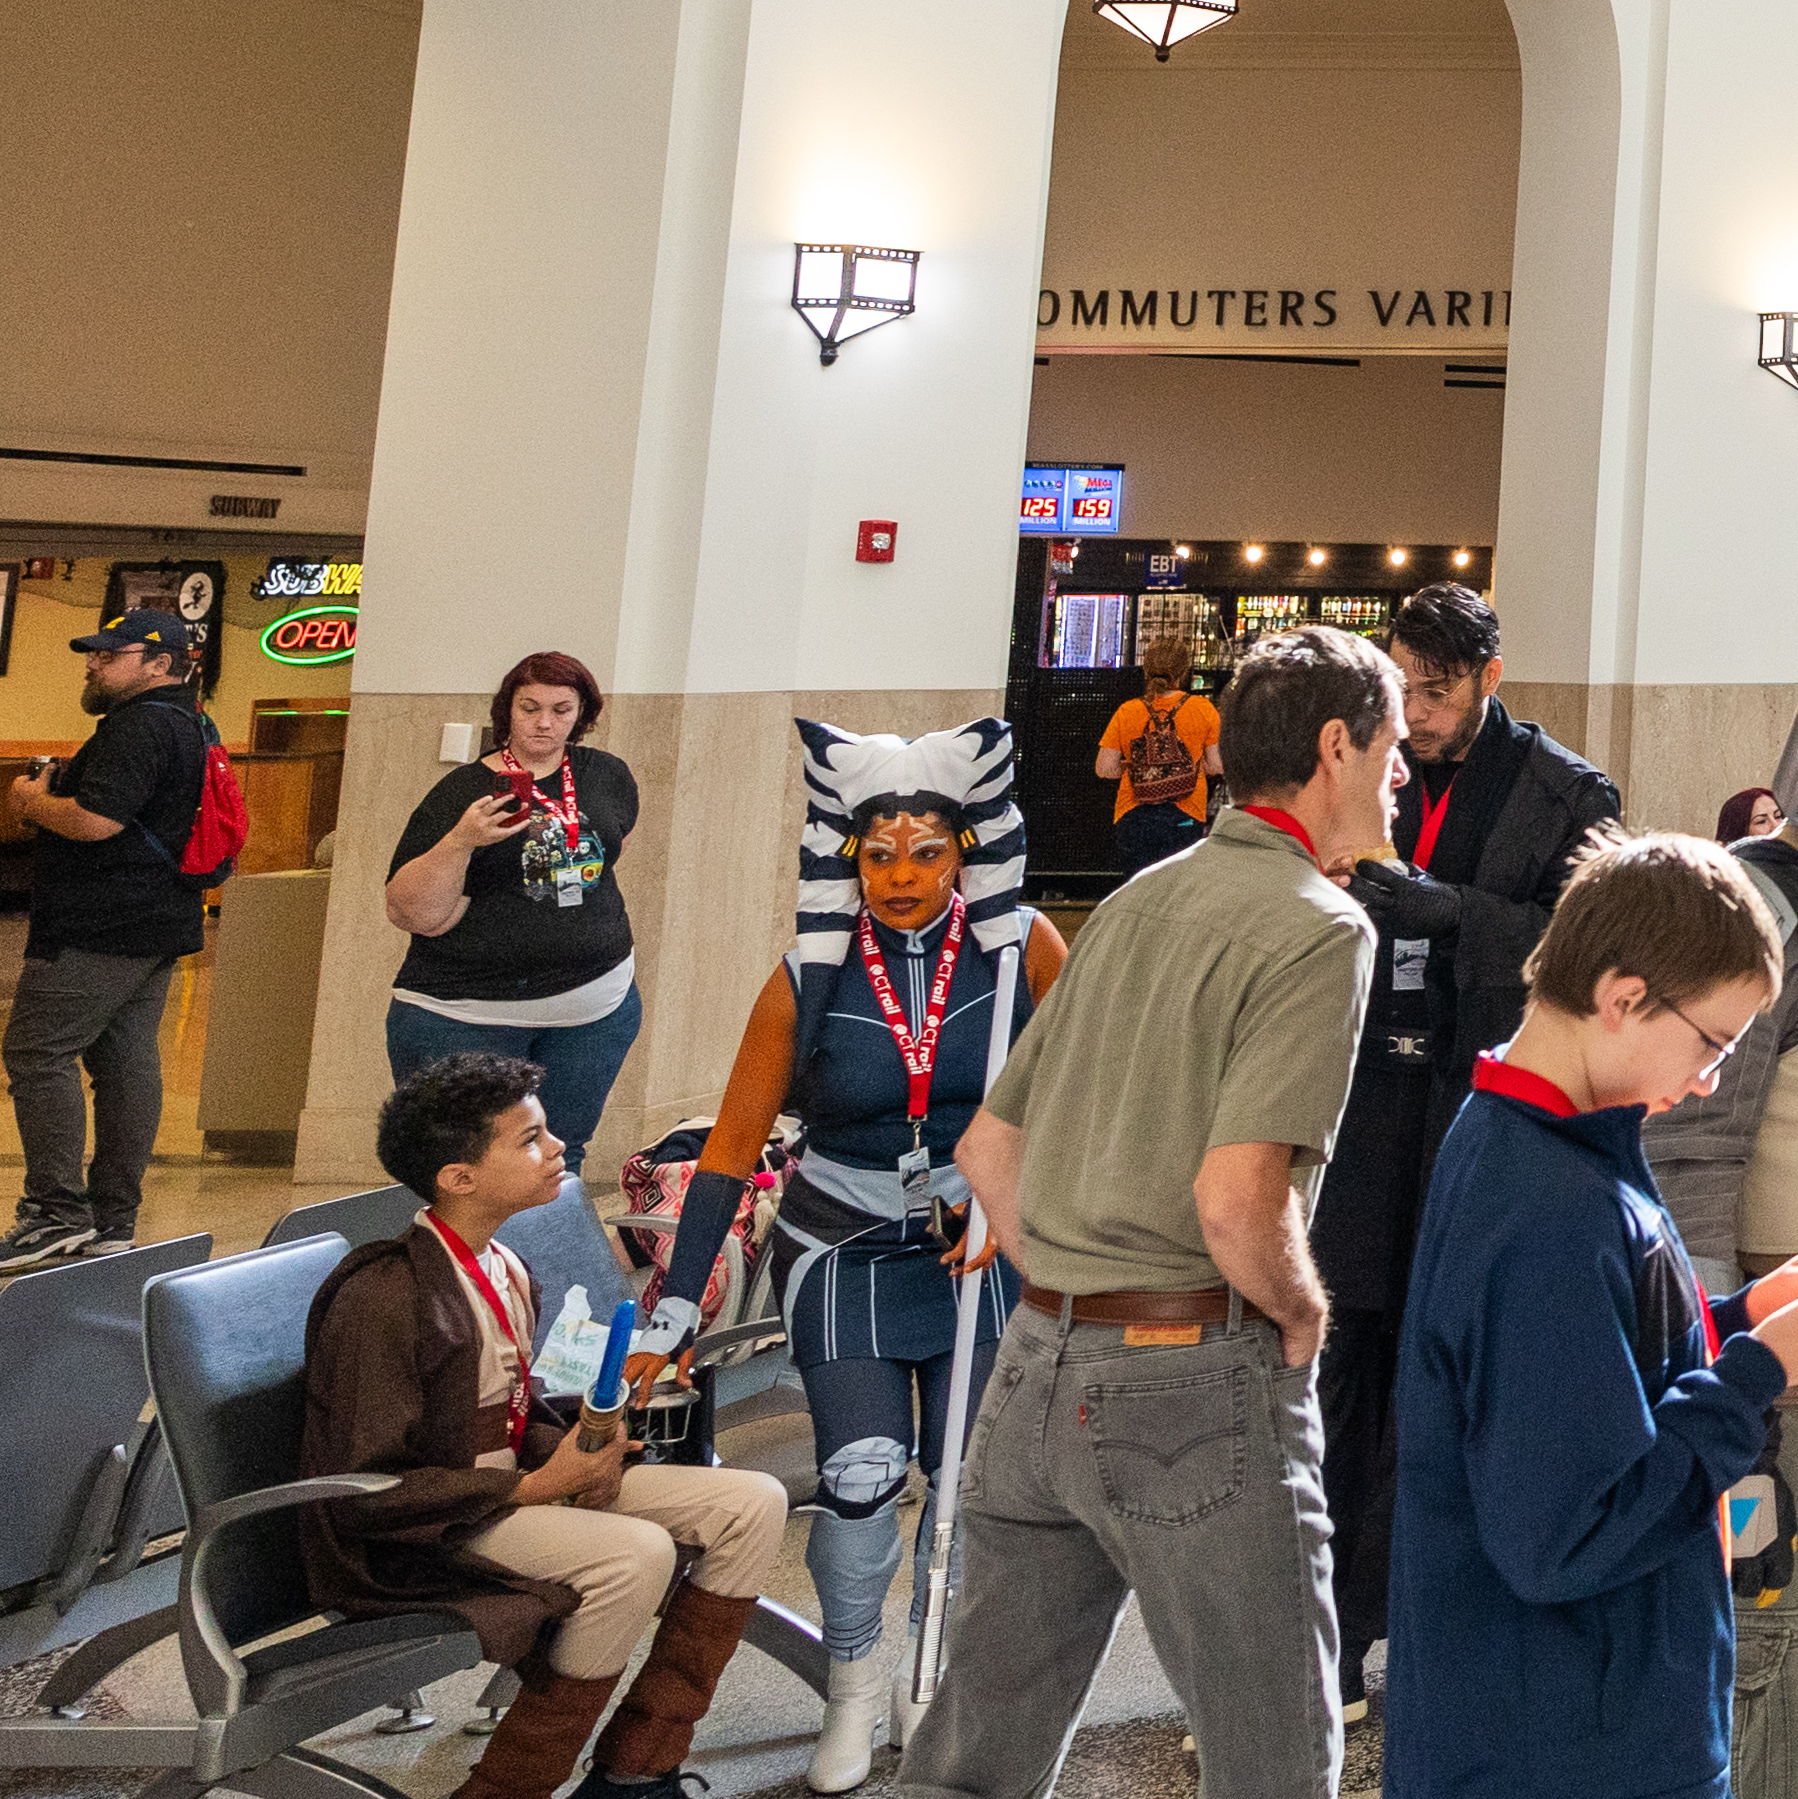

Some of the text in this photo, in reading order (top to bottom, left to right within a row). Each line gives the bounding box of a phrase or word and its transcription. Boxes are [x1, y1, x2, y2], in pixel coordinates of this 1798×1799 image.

[1037, 290, 1511, 327] OMMUTERS VARI
[1078, 499, 1111, 517] 159
[1073, 517, 1111, 526] MILLION
[1150, 555, 1178, 573] EBT
[262, 564, 363, 595] SUBWA
[276, 621, 357, 649] OPEN
